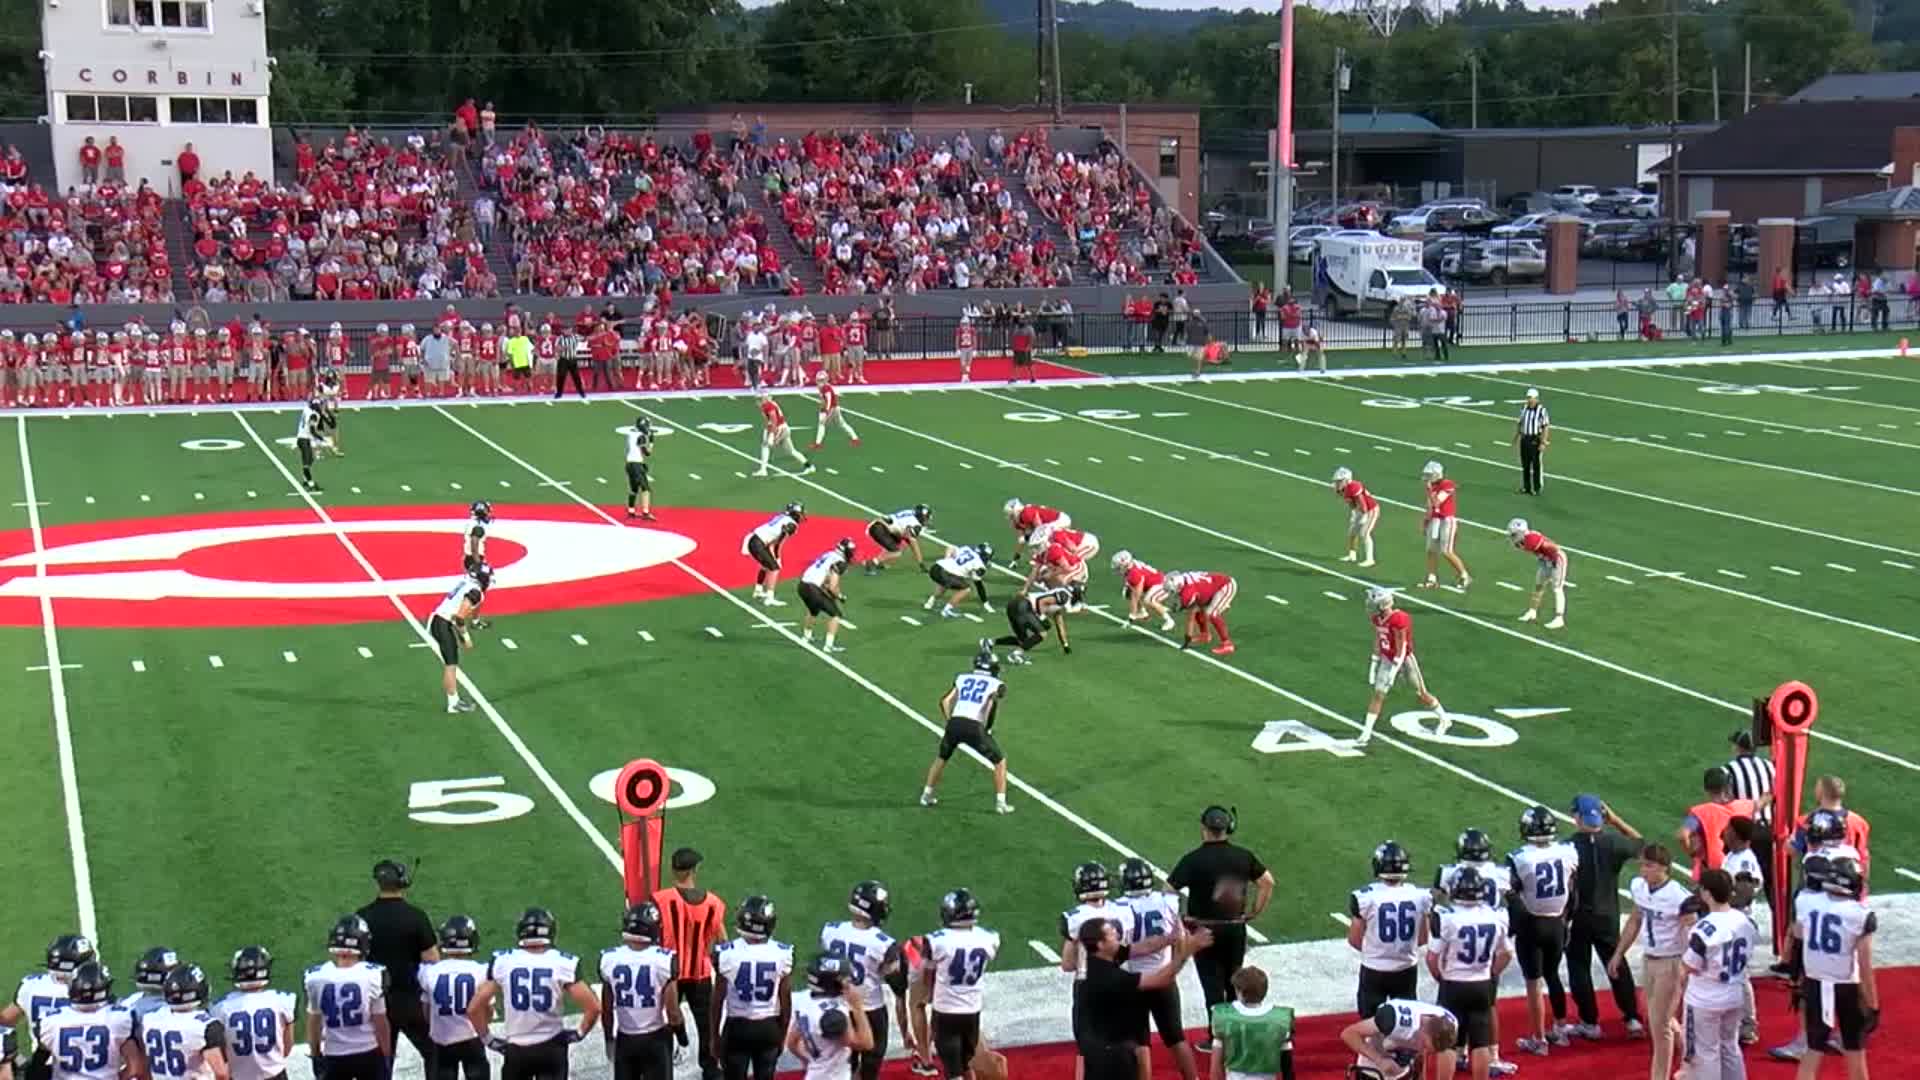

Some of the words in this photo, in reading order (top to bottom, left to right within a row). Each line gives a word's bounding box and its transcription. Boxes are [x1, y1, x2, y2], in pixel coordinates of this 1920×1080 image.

[79, 68, 243, 86] CORBIN
[960, 677, 989, 704] 22
[1252, 711, 1519, 757] 40
[1535, 859, 1565, 899] 21
[1377, 901, 1417, 943] 66
[1457, 923, 1497, 965] 37
[1808, 909, 1843, 954] 16
[612, 964, 656, 1009] 24
[734, 961, 777, 1002] 45
[948, 947, 987, 986] 43
[320, 983, 363, 1028] 42
[433, 973, 476, 1016] 40
[510, 967, 553, 1013] 65
[59, 1025, 110, 1073] 53
[146, 1029, 186, 1077] 26
[230, 1007, 276, 1057] 39
